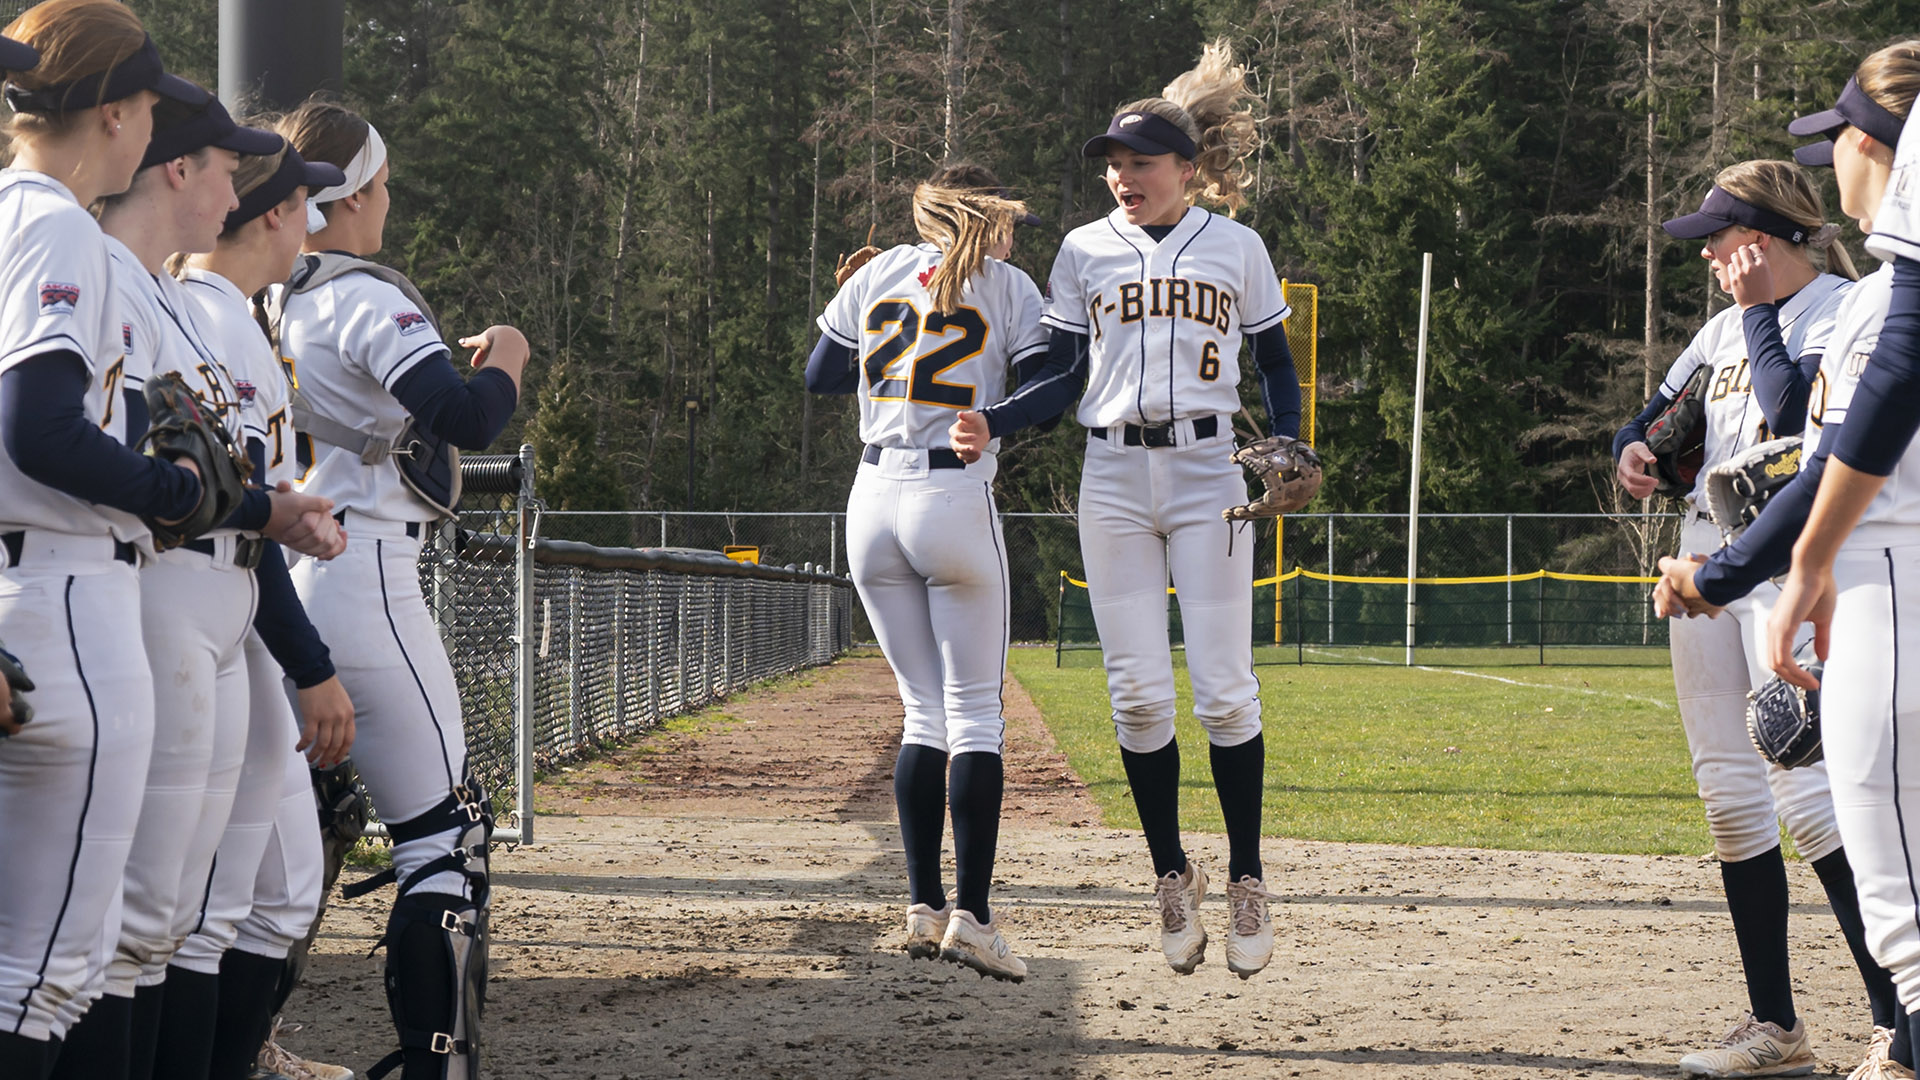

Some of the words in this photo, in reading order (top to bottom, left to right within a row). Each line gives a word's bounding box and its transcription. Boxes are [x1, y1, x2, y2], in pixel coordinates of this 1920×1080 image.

[1089, 277, 1232, 342] T-BIRDS
[863, 299, 990, 410] 22
[1198, 340, 1221, 382] 6
